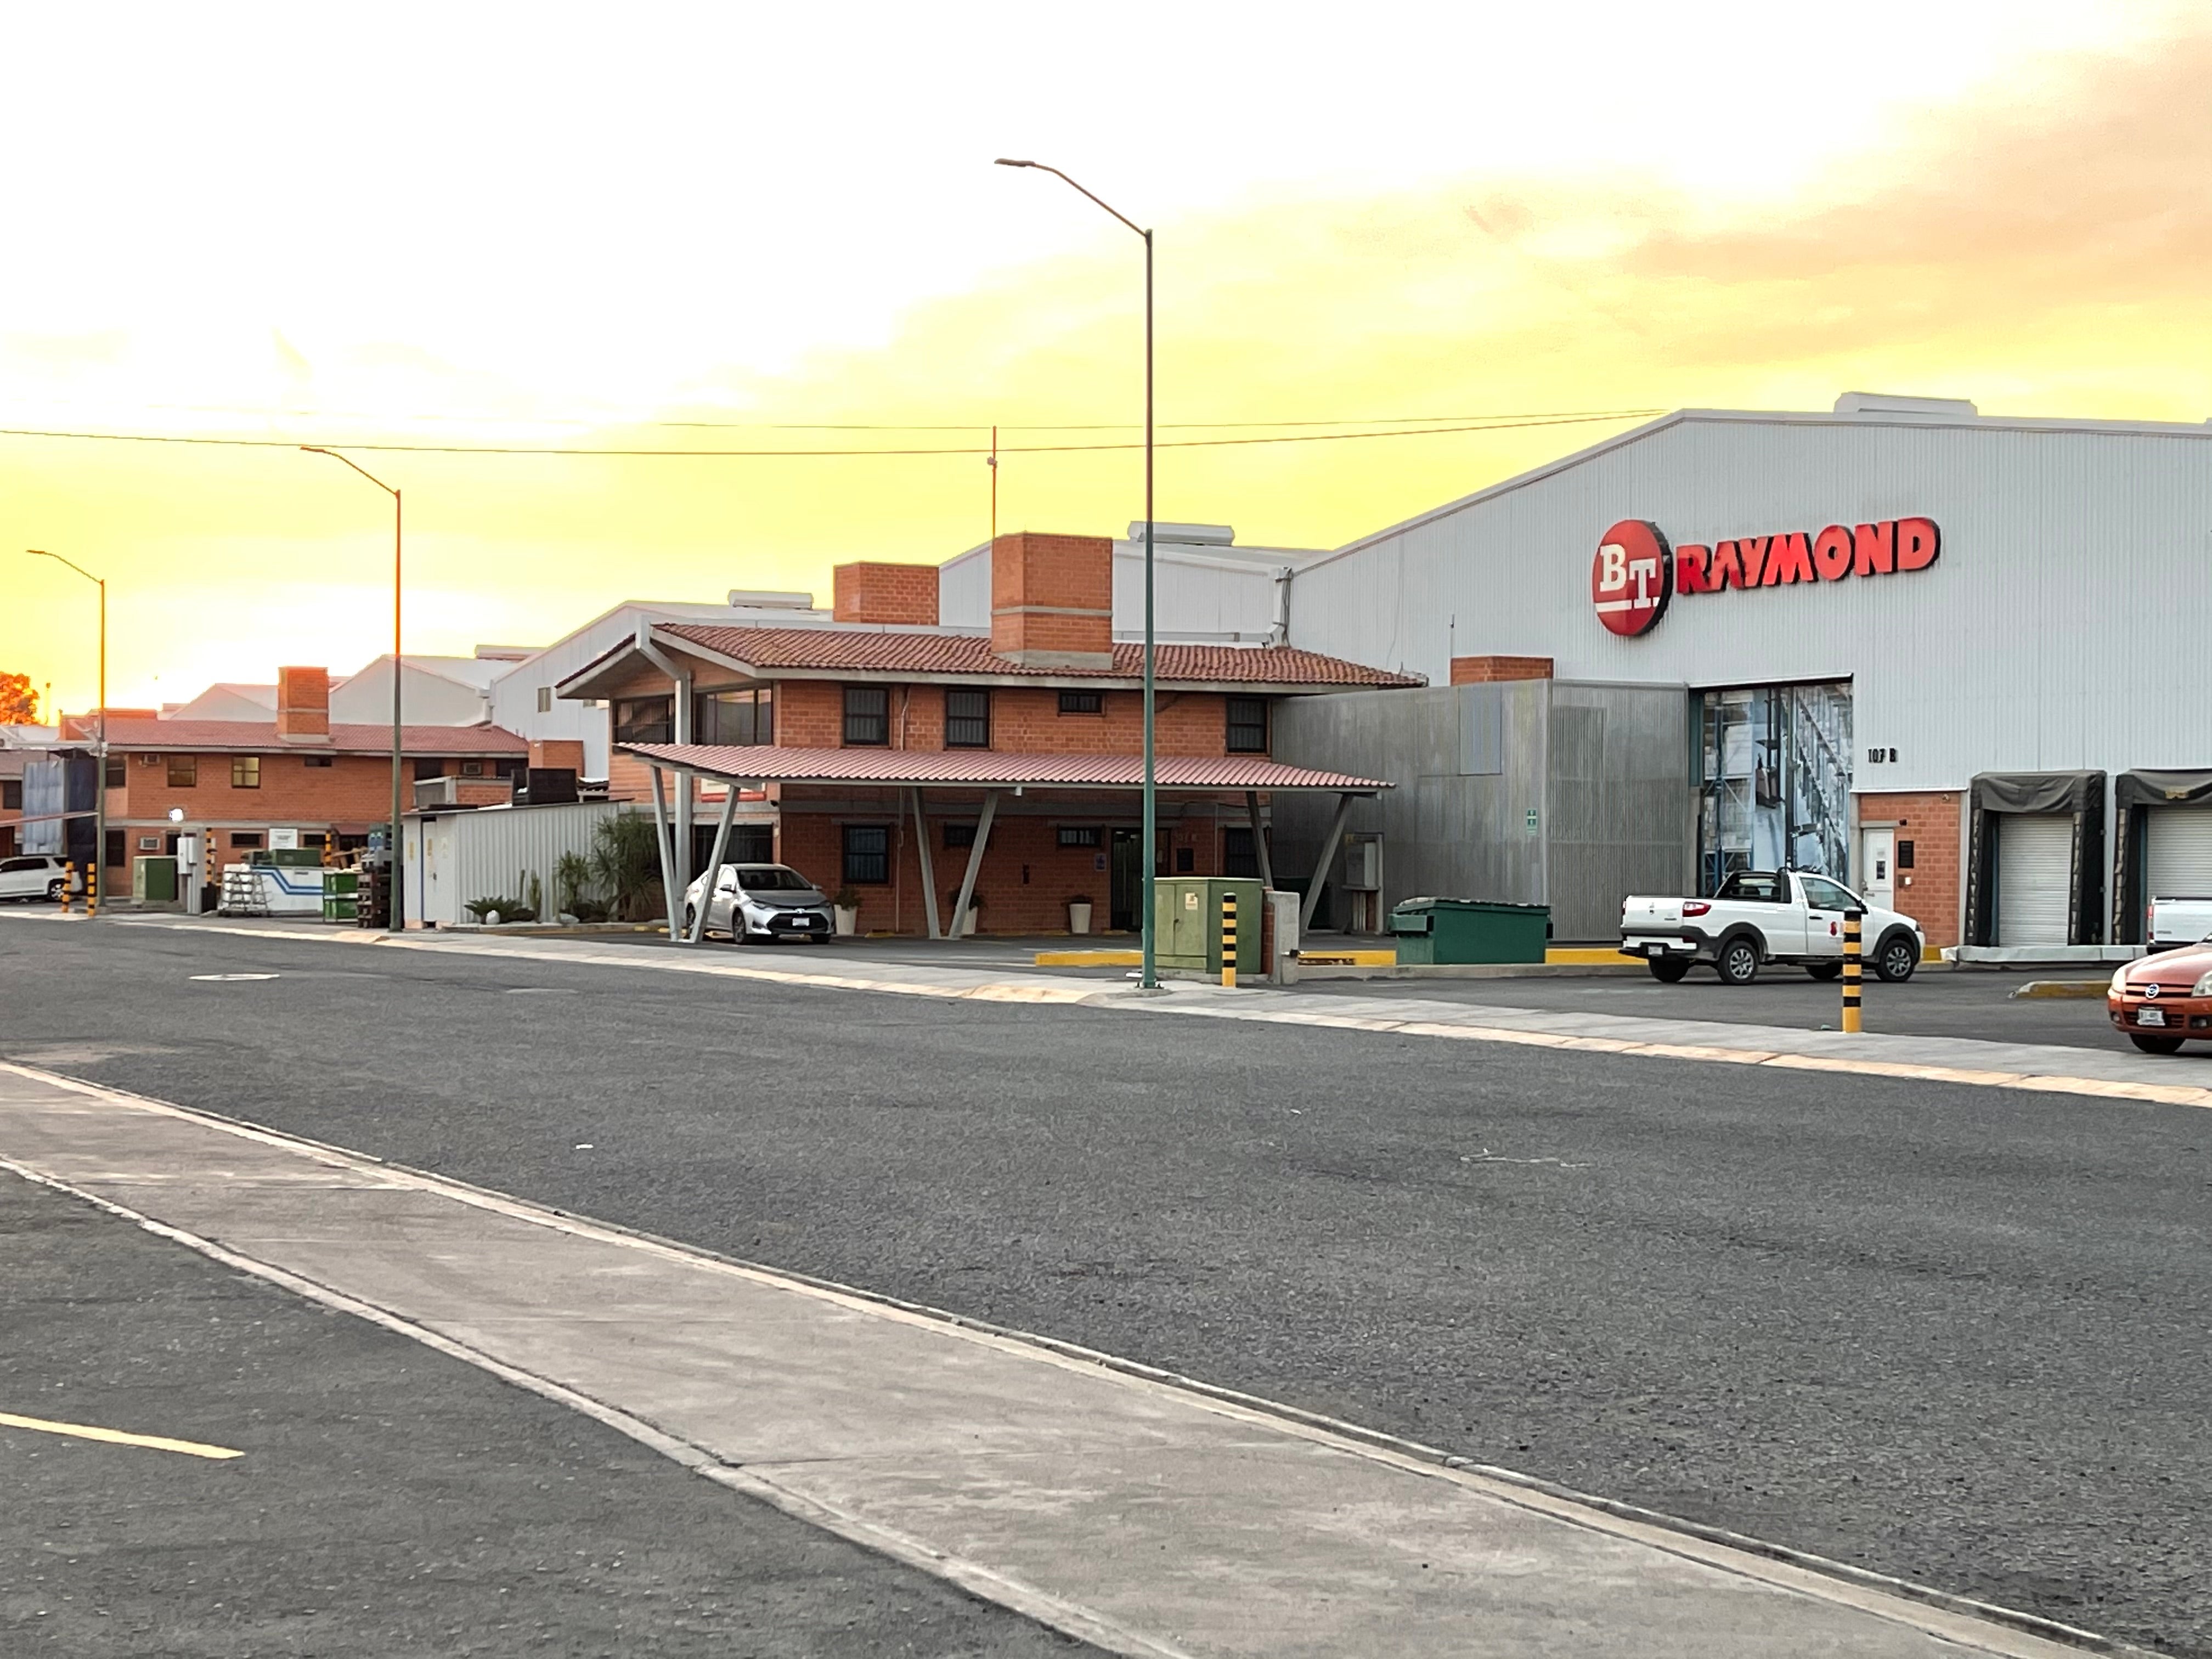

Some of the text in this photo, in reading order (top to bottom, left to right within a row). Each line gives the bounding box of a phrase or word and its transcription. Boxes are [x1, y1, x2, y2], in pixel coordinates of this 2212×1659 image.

[1676, 517, 1940, 595] RAYMOND
[1868, 748, 1898, 763] 107 B
